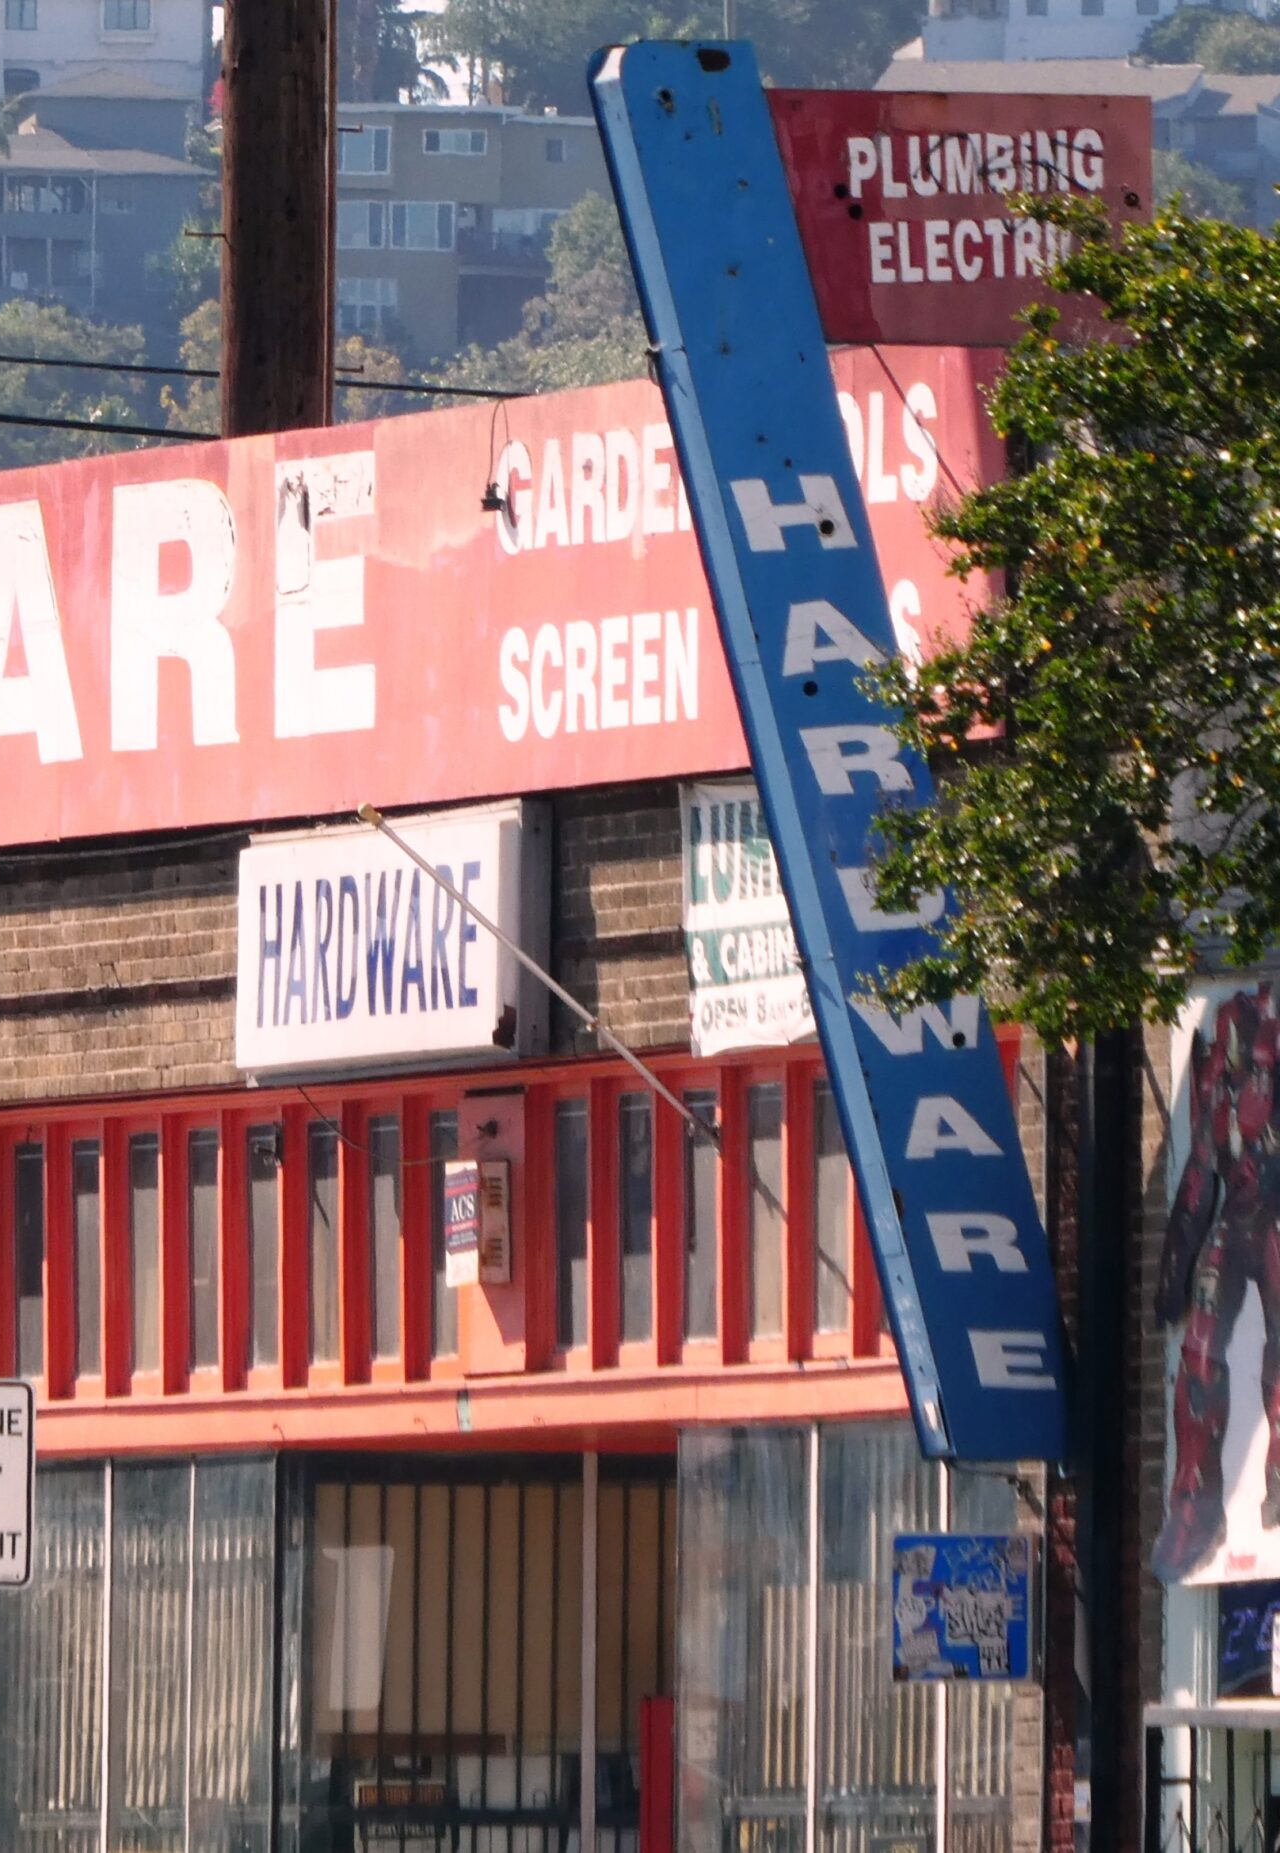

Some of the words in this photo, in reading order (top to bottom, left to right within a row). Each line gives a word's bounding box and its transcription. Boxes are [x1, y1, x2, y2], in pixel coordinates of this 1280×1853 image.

[848, 127, 1105, 198] PLUMBING
[496, 422, 691, 555] GARDE
[498, 608, 699, 742] SCREEN
[257, 860, 482, 1030] HARDWARE
[451, 1193, 476, 1222] ACS
